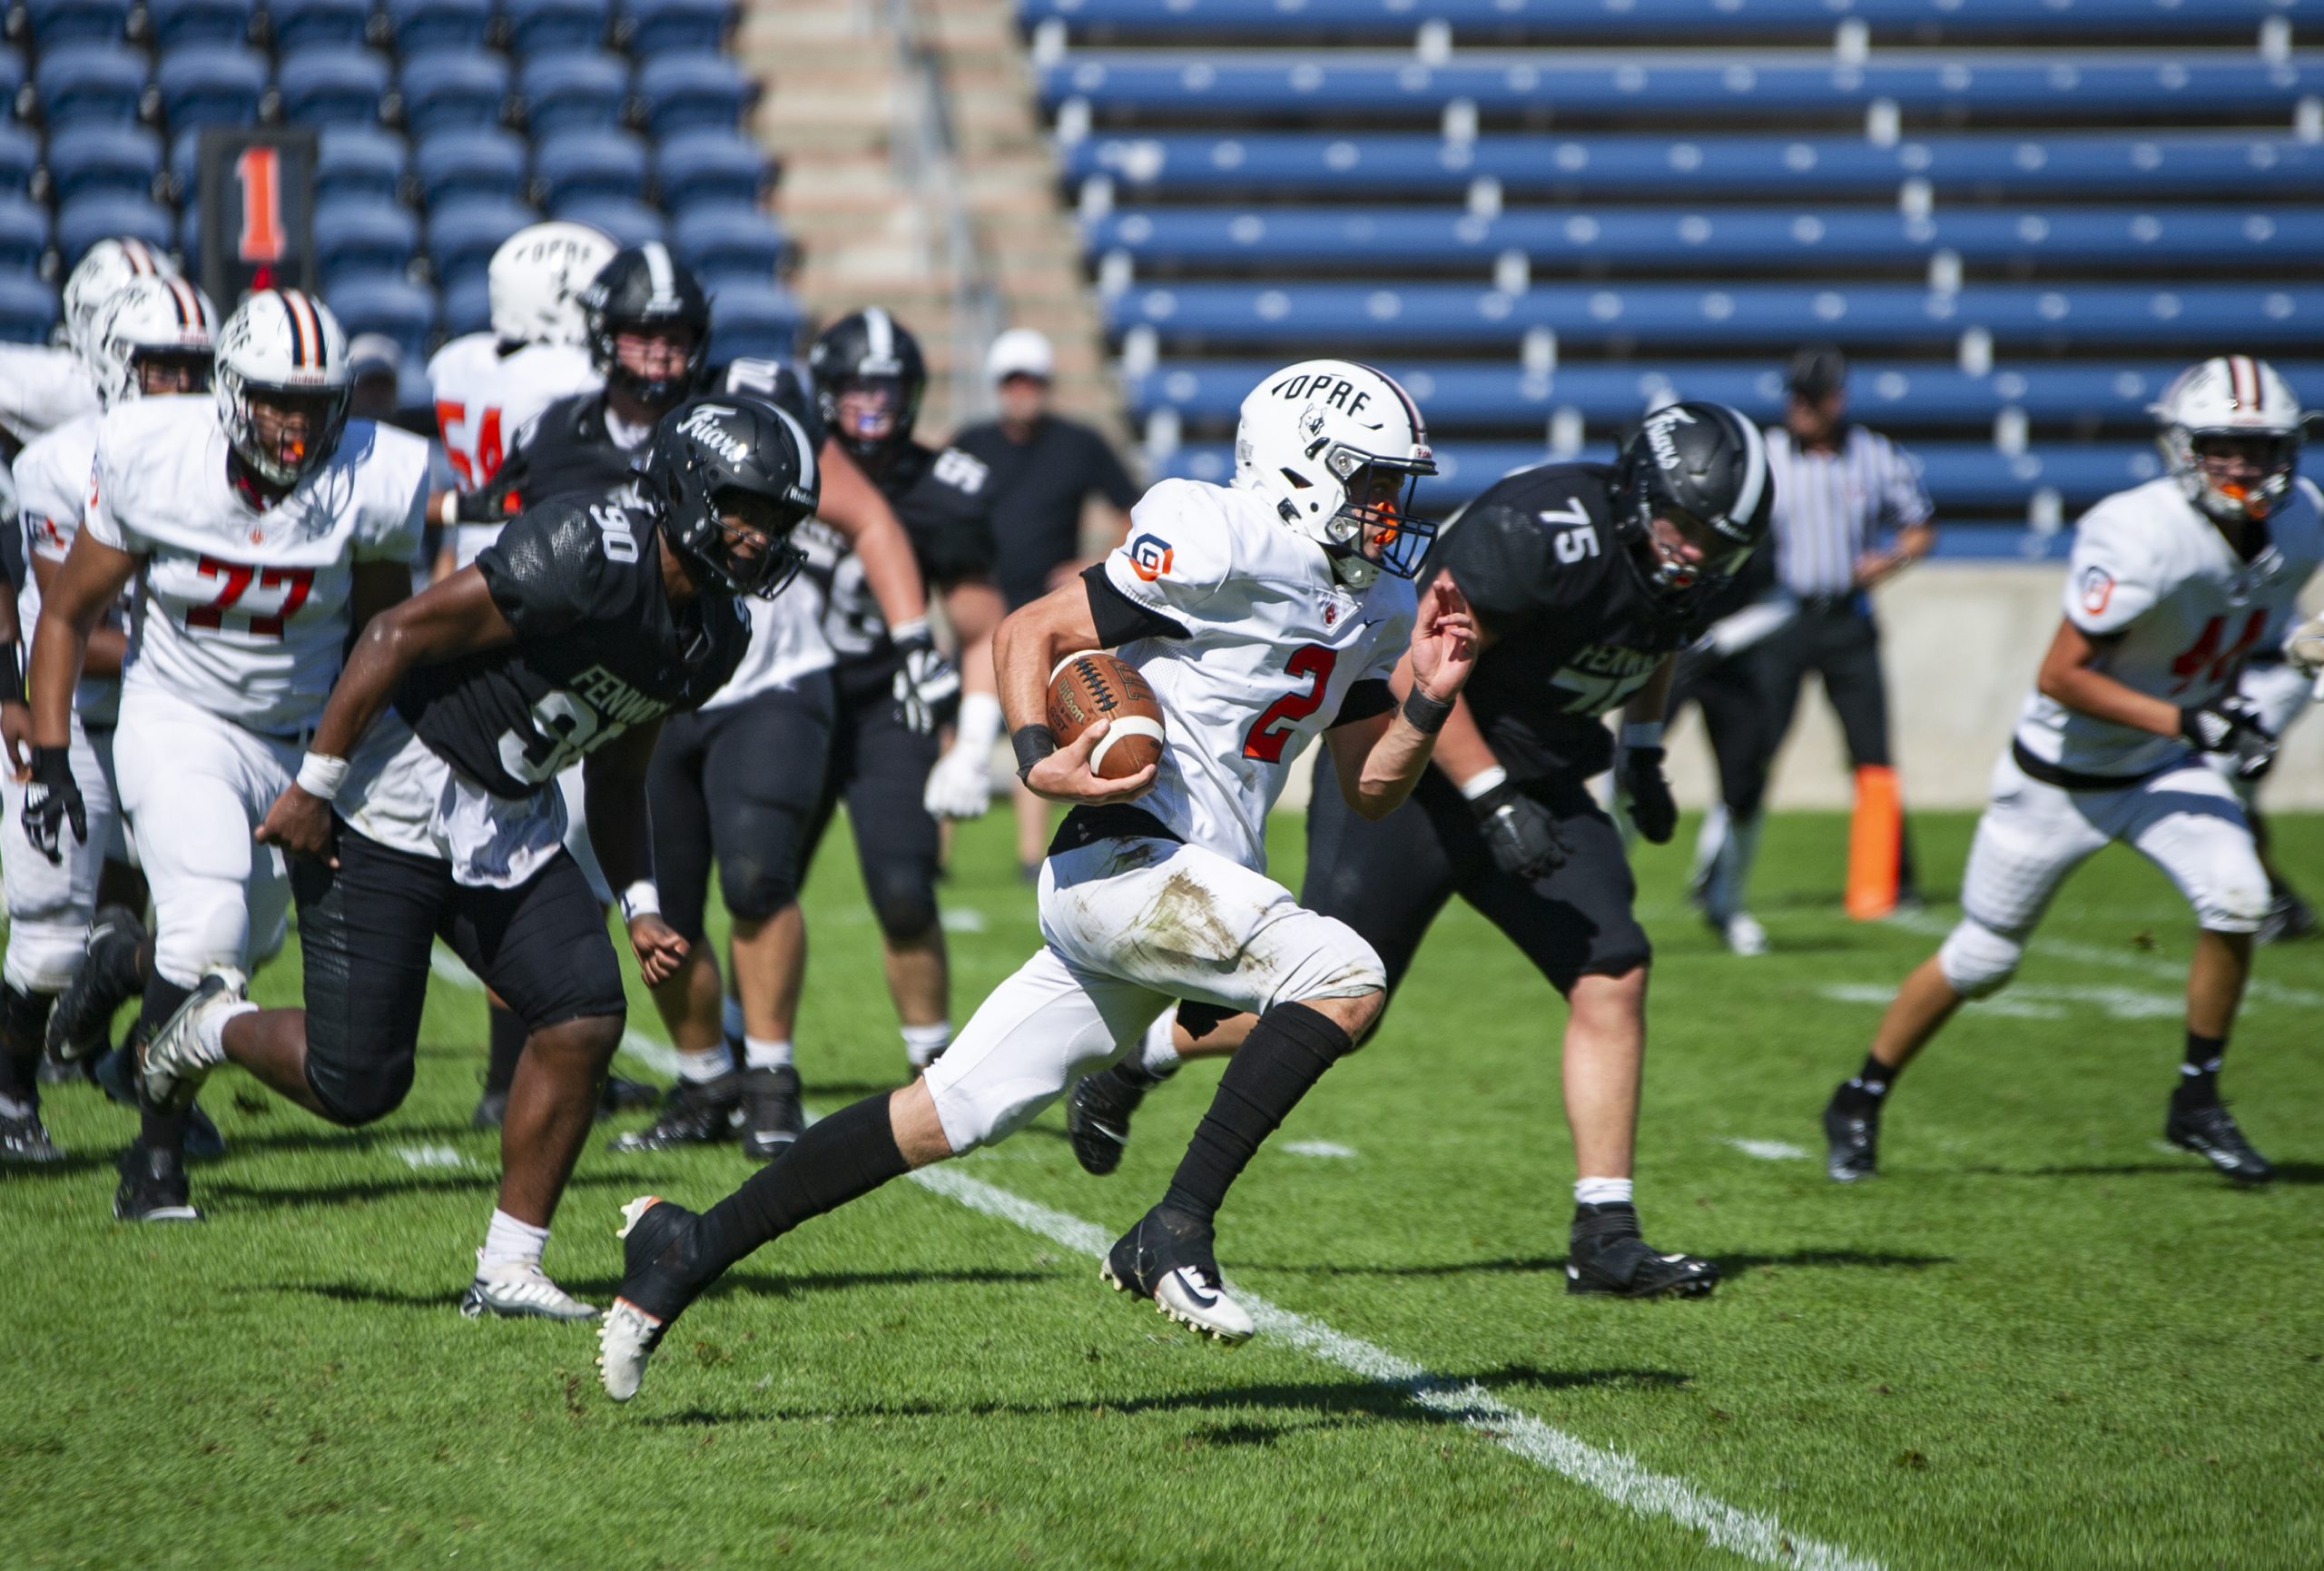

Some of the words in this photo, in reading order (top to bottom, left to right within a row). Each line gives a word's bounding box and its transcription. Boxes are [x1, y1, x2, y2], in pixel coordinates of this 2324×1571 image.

[235, 145, 287, 261] 1
[1285, 375, 1372, 418] OPRF
[676, 404, 747, 462] Friars
[589, 504, 639, 564] 90
[1539, 497, 1600, 565] 75
[186, 553, 316, 642] 77
[1057, 676, 1086, 725] Wilson
[1242, 642, 1339, 765] 2
